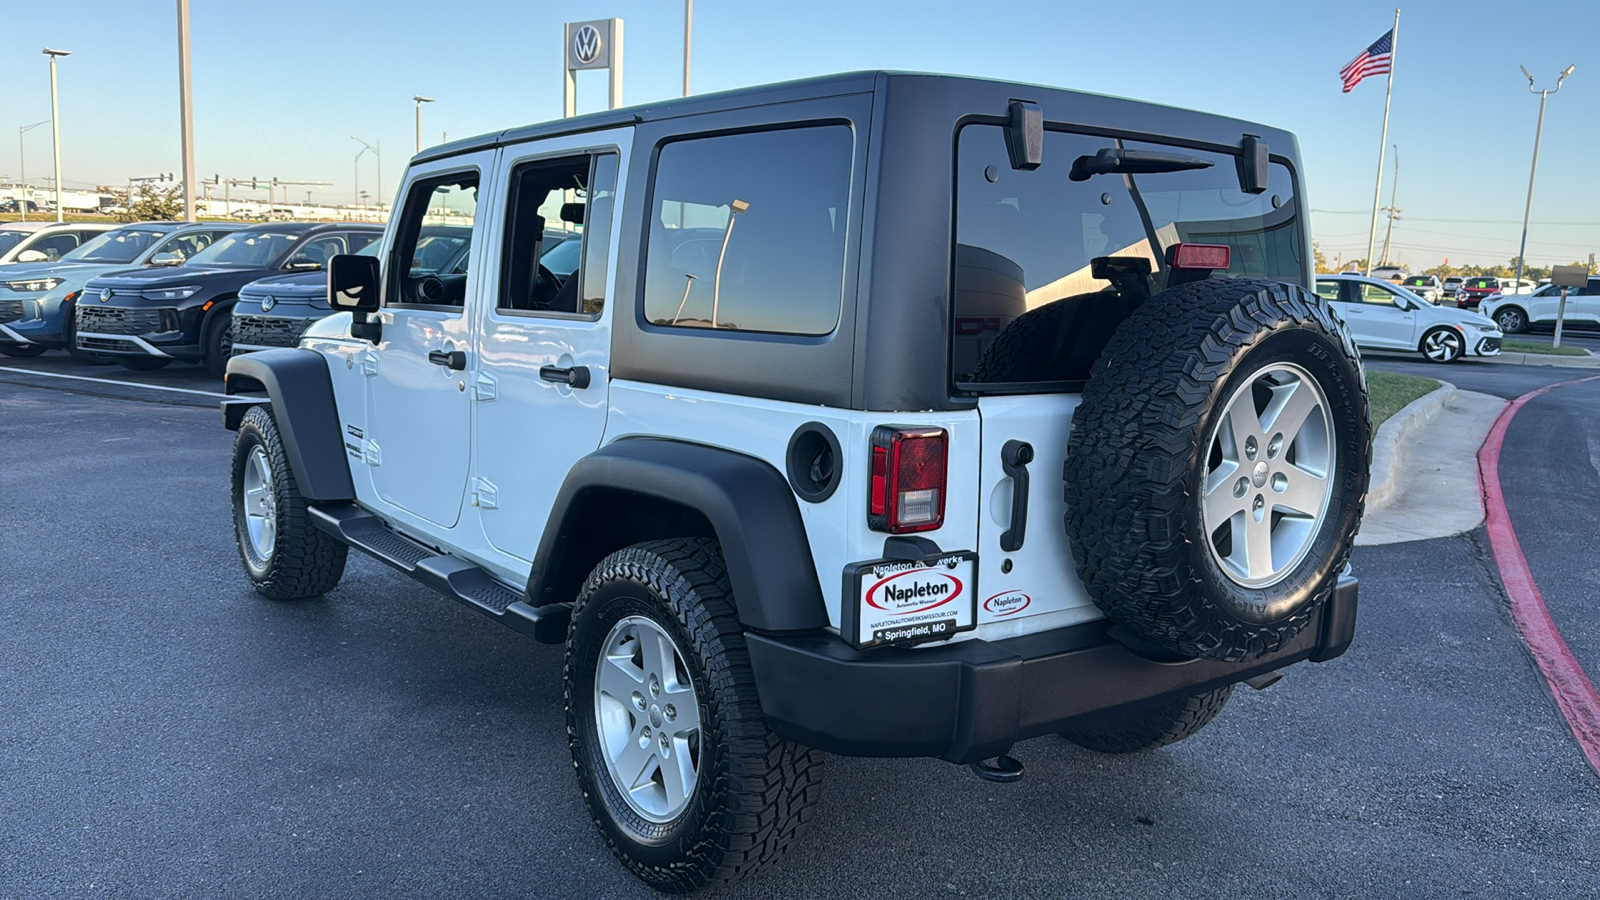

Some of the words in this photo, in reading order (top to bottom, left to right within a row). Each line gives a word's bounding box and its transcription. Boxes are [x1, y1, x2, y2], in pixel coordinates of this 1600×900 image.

[575, 25, 601, 63] VW
[873, 562, 912, 574] Napleton
[884, 581, 948, 602] Napleton
[994, 597, 1022, 607] Napleton
[885, 626, 931, 640] Springfield,
[932, 623, 946, 633] MO
